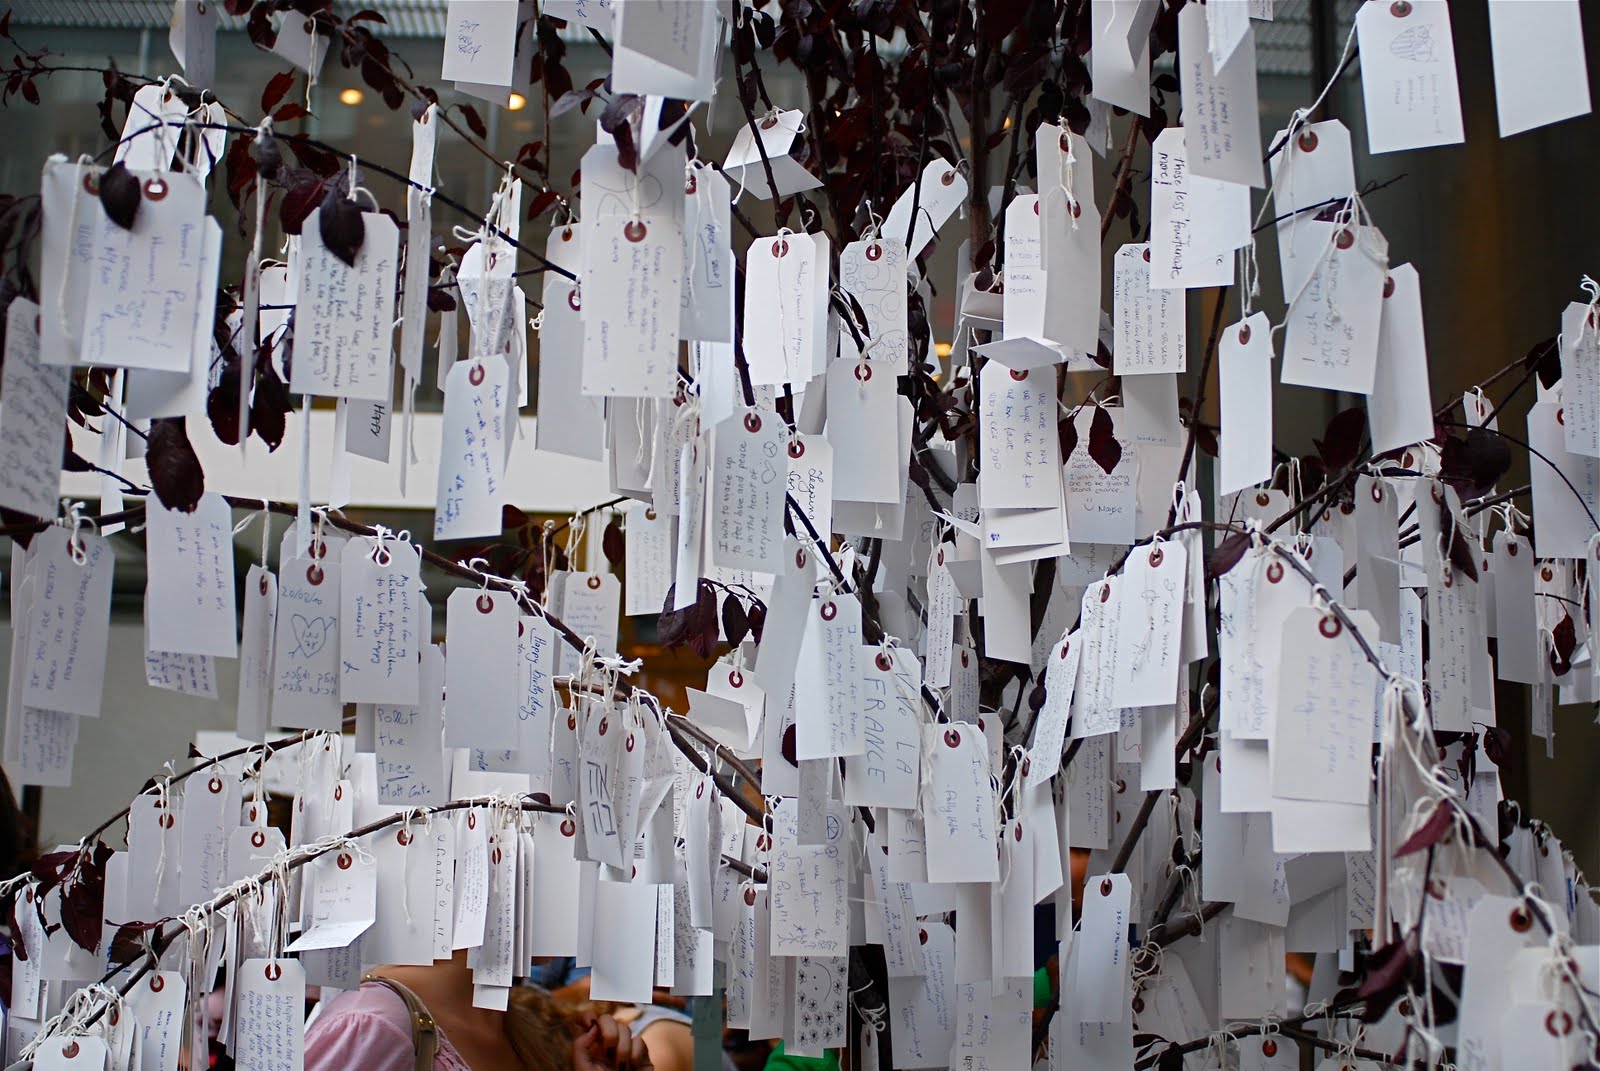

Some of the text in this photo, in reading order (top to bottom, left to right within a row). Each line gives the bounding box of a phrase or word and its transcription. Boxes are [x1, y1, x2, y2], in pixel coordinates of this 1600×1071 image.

[1154, 151, 1172, 185] more!
[1173, 156, 1187, 186] those
[1173, 190, 1188, 211] less
[348, 361, 360, 387] will
[370, 403, 387, 439] Happy
[1023, 430, 1033, 445] the
[1037, 448, 1049, 466] NY
[749, 468, 758, 481] of
[718, 456, 738, 553] I wish to wake up
[730, 440, 750, 555] to feel love and peace
[747, 483, 758, 511] heart
[745, 514, 756, 532] the
[746, 534, 755, 545] in
[758, 515, 773, 561] everyone
[376, 577, 387, 588] to
[395, 574, 411, 588] My
[376, 592, 387, 605] be
[848, 624, 858, 635] I
[525, 635, 549, 665] Happy
[848, 644, 858, 663] wish
[378, 731, 405, 747] the
[862, 677, 888, 785] FRANCE
[895, 740, 918, 776] LA
[960, 1040, 974, 1049] I
